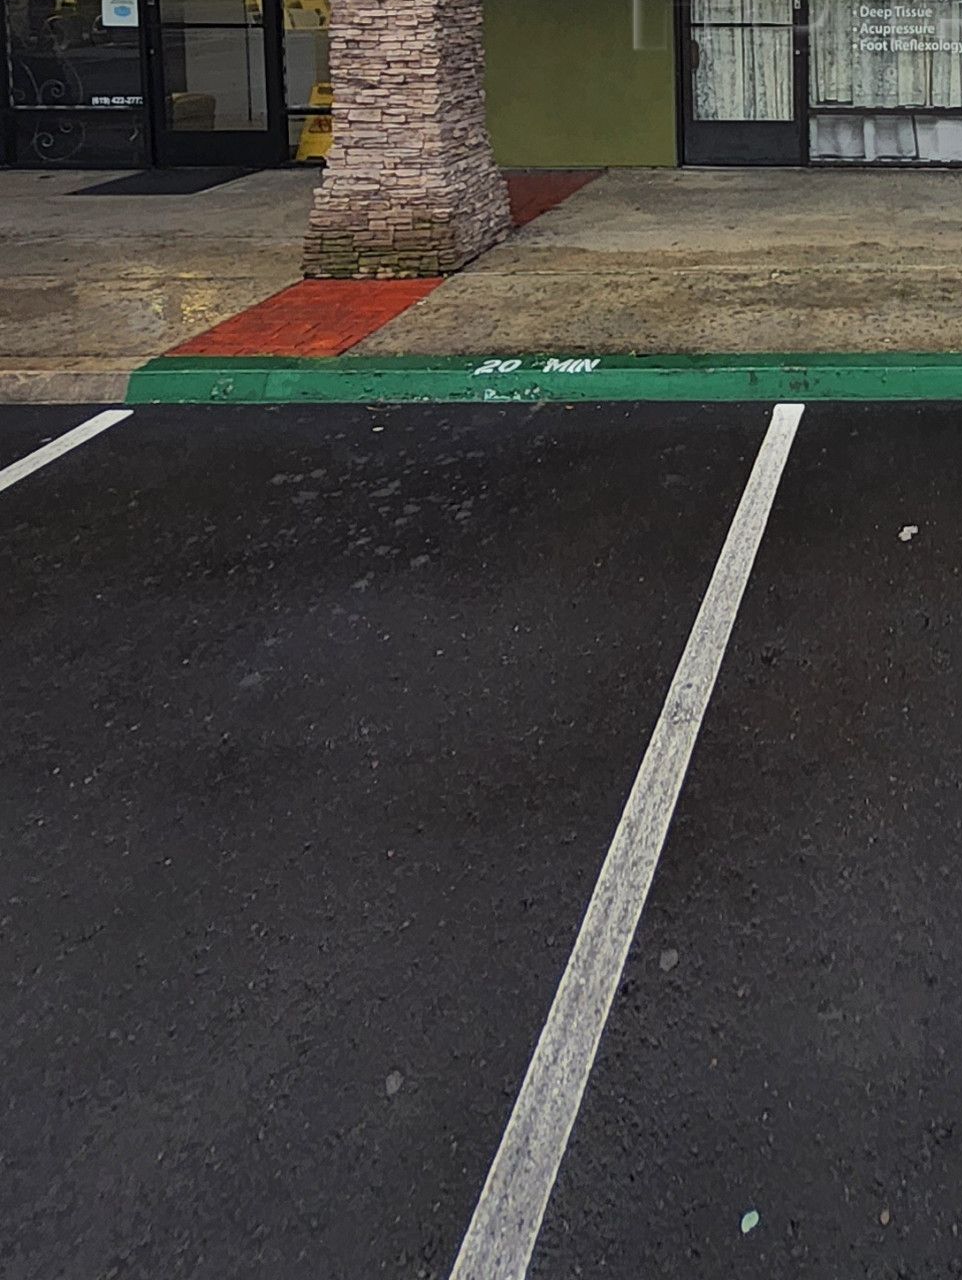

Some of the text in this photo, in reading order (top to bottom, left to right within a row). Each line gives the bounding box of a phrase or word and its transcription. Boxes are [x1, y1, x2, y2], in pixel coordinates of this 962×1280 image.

[860, 5, 933, 20] Deep Tissue
[860, 22, 936, 37] Acupressure
[860, 39, 893, 52] Foot
[474, 357, 601, 376] 20 MIN
